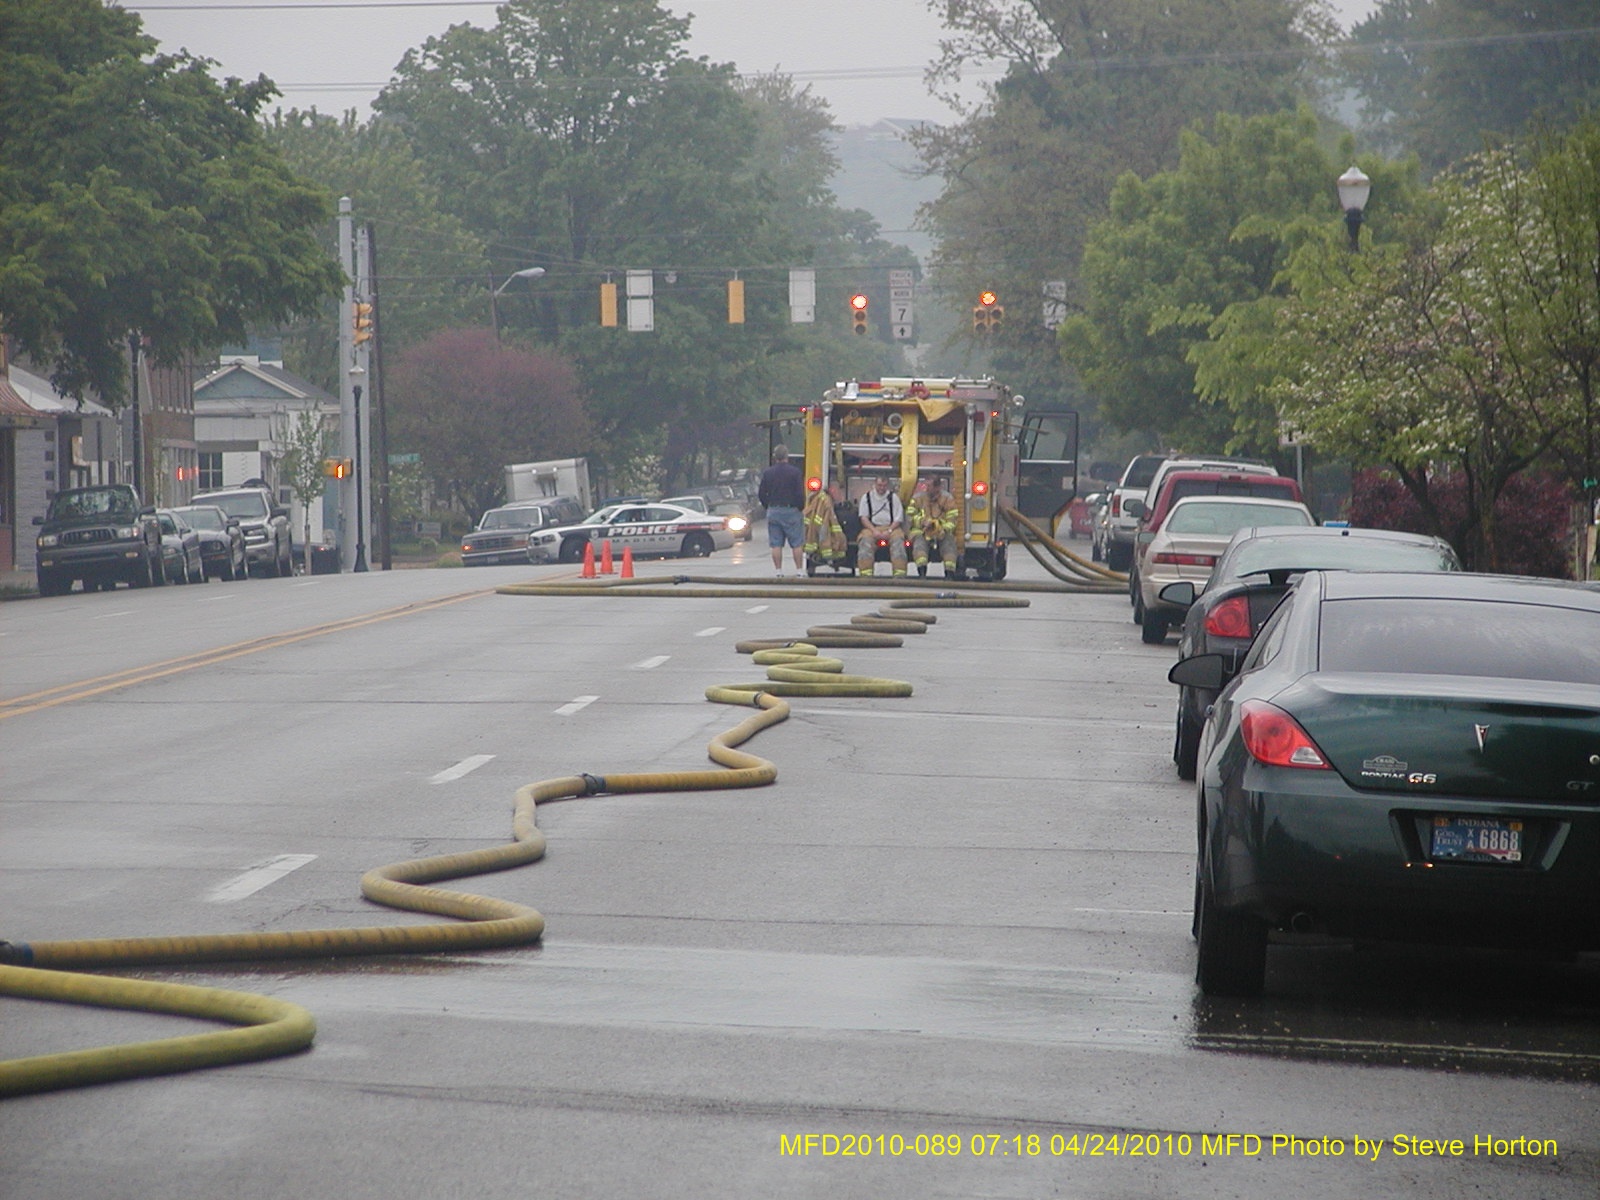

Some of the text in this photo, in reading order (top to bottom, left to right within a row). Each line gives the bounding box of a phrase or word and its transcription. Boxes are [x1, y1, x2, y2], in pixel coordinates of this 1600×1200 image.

[898, 308, 906, 321] 7
[607, 525, 678, 536] POLICE
[1408, 773, 1437, 784] G6
[1566, 780, 1594, 790] GT
[1458, 819, 1500, 829] INDIANA
[1480, 829, 1519, 851] 6868
